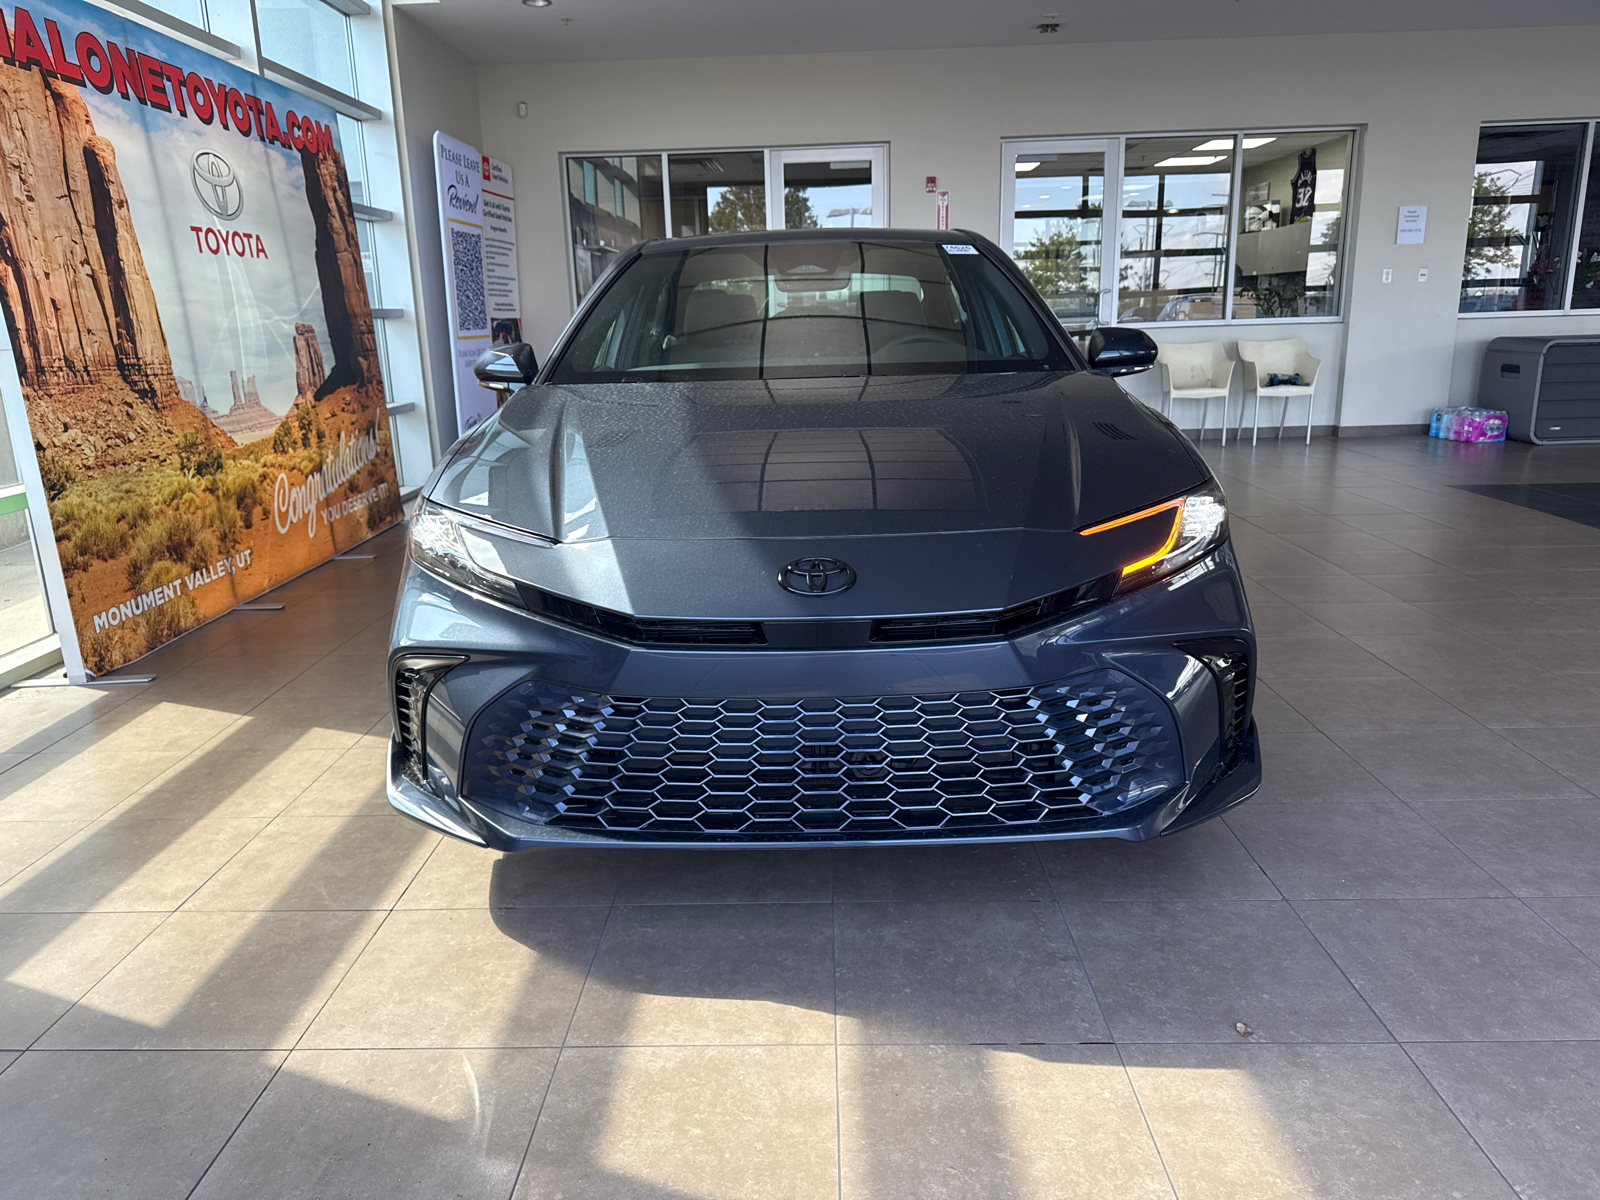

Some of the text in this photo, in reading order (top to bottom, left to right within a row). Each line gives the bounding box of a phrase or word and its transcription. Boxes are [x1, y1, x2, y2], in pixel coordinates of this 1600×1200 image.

[441, 143, 480, 174] PLEASE LEAVE
[465, 174, 471, 188] A
[1295, 186, 1313, 208] 32
[447, 184, 479, 215] Review!
[190, 225, 269, 259] TOYOTA
[274, 408, 380, 538] Congratulations!
[321, 482, 390, 524] YOU DESERVE IT!
[92, 548, 251, 634] MONUMENT VALLEY, UT
